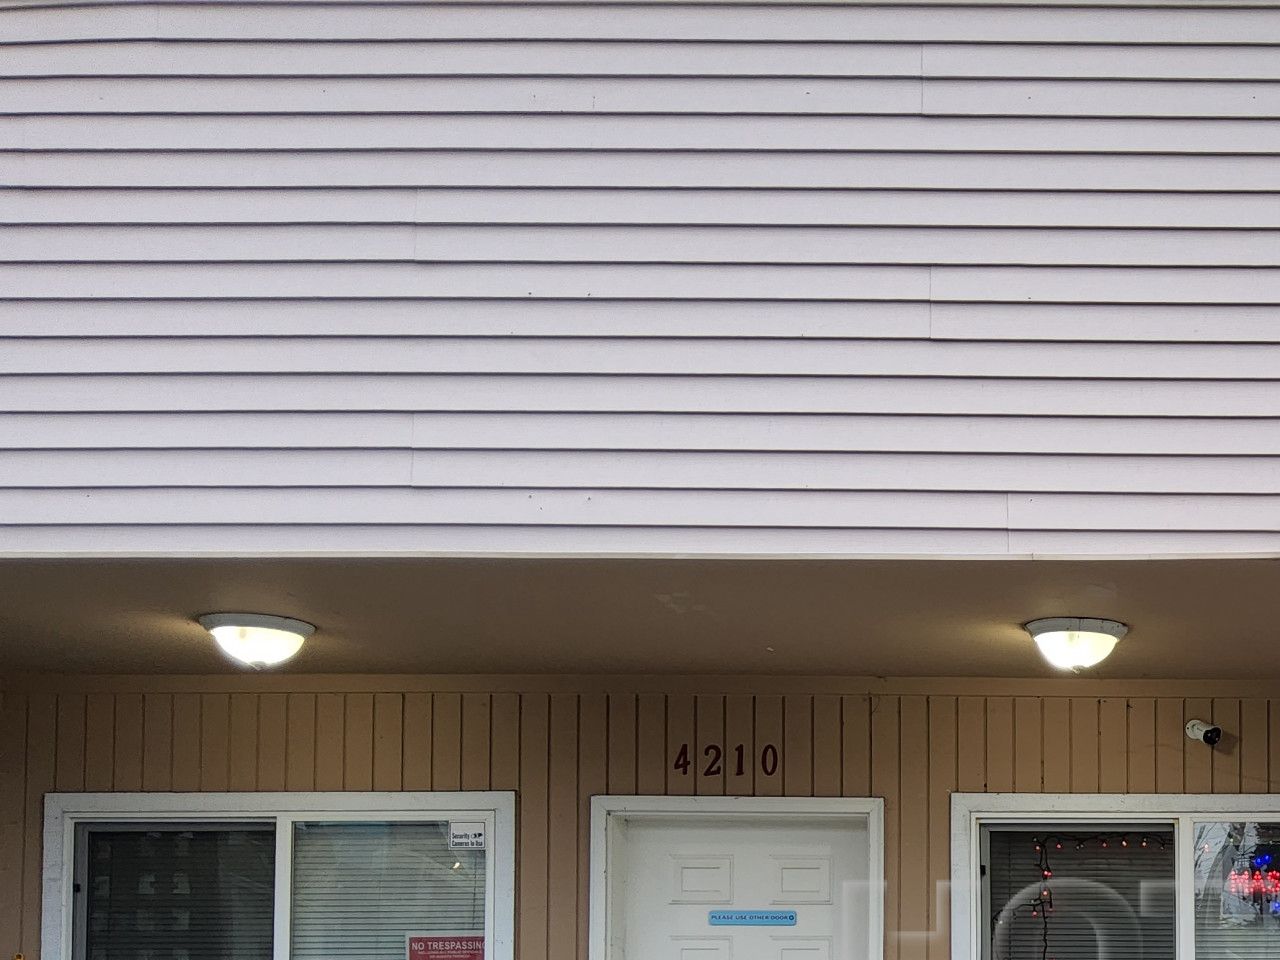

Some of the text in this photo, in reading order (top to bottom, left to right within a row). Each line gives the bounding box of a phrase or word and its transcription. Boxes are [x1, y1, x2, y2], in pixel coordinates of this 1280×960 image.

[673, 743, 779, 777] 4210
[452, 832, 470, 840] Security
[411, 941, 425, 951] NO
